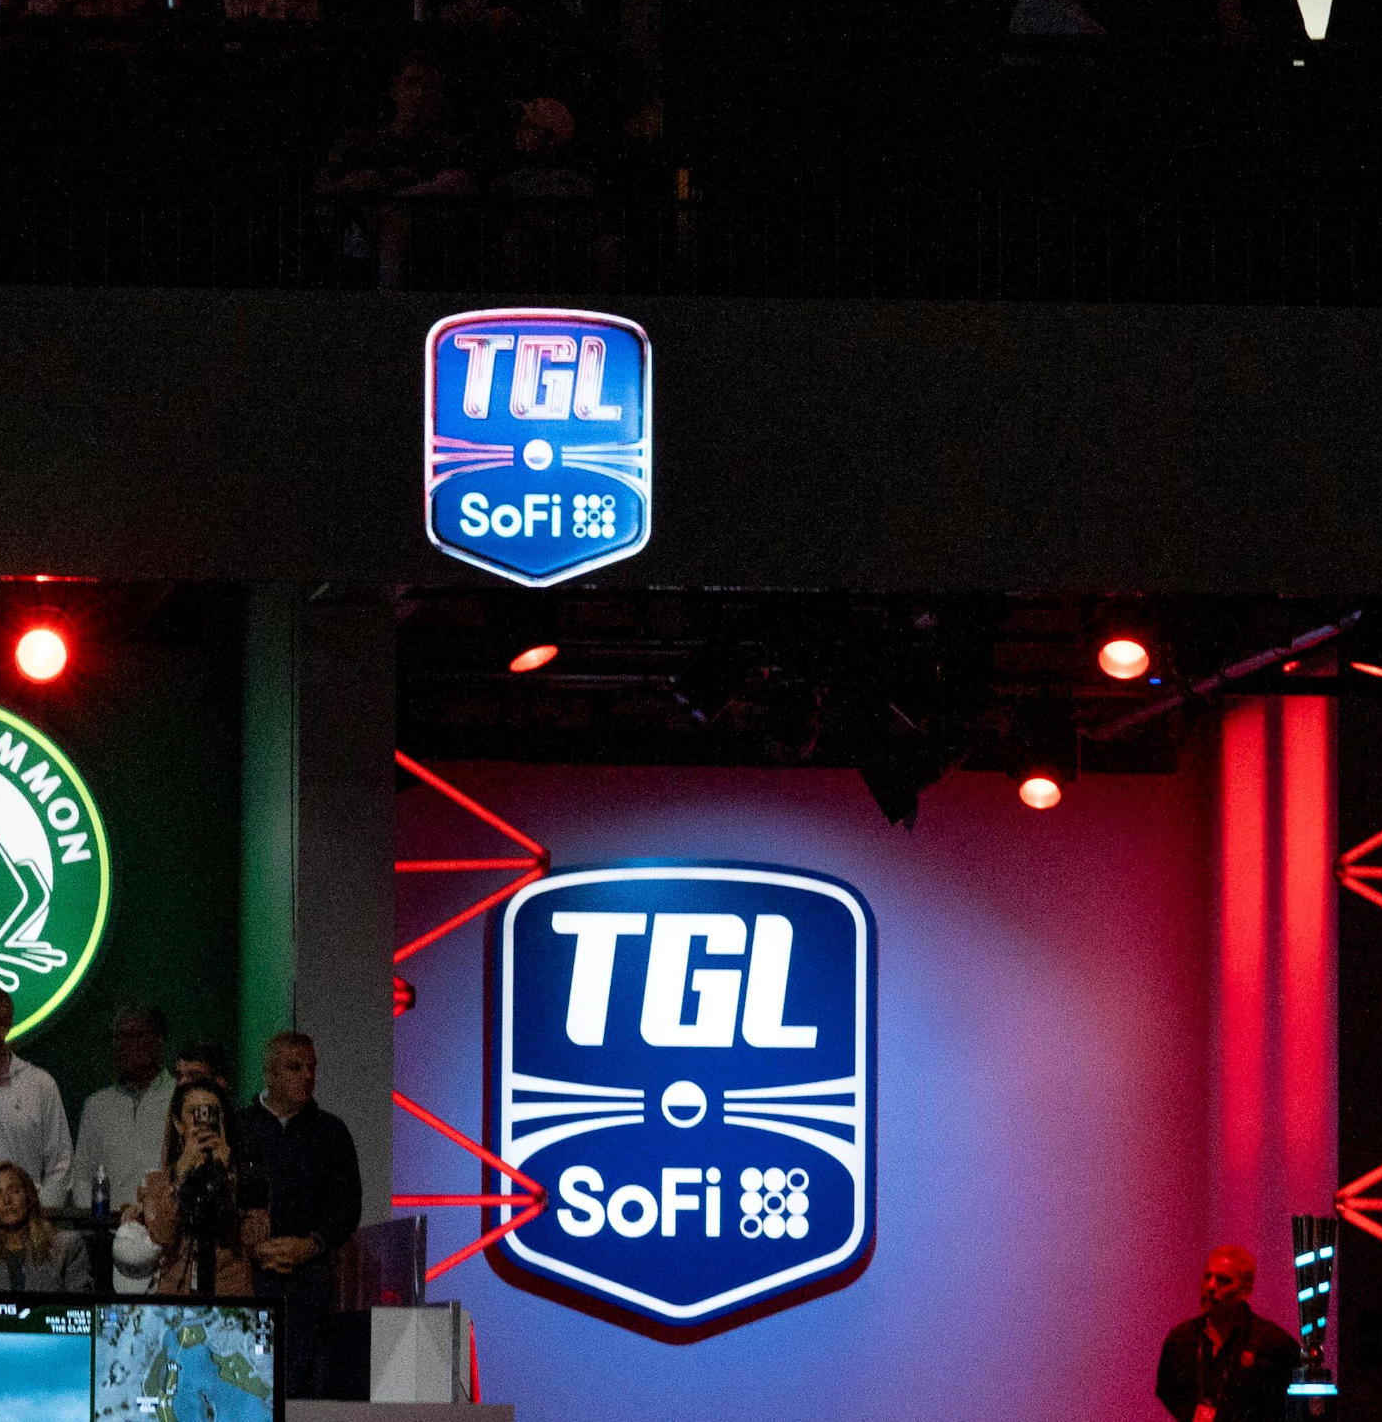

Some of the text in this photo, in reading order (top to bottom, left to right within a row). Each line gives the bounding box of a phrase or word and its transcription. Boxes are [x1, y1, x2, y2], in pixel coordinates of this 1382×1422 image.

[454, 334, 622, 421] TGL
[459, 492, 562, 538] SoFi
[551, 911, 818, 1049] TGL
[556, 1165, 722, 1238] SoFi
